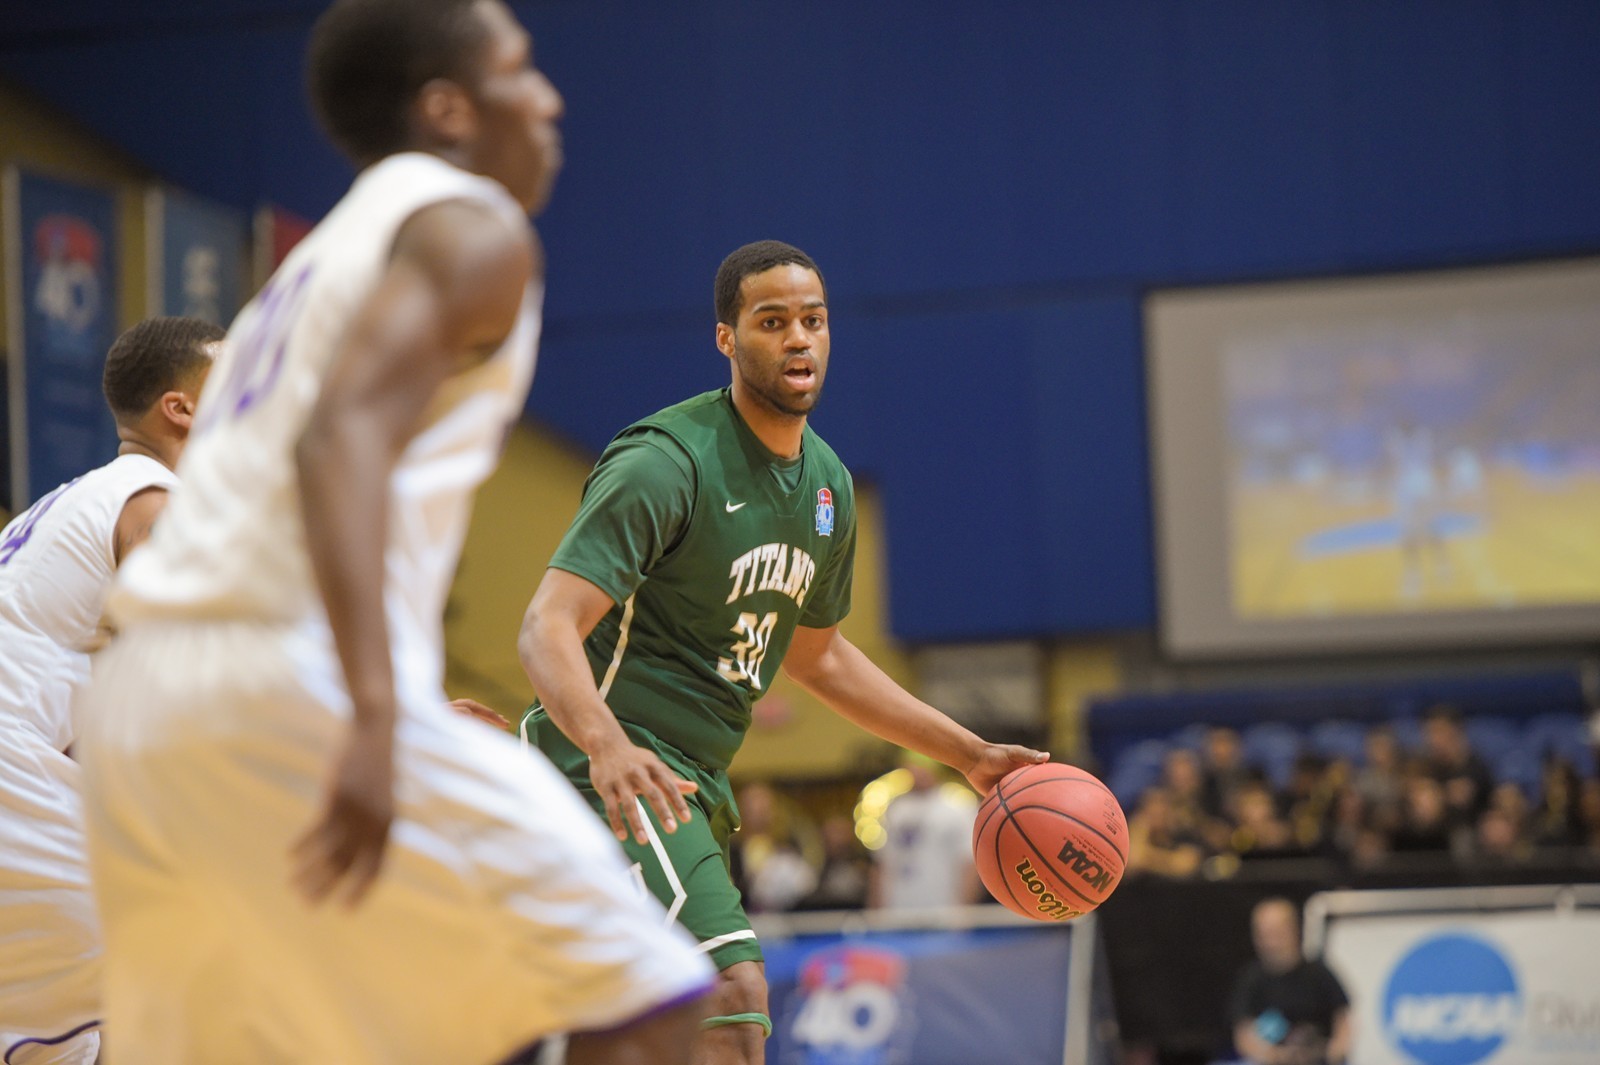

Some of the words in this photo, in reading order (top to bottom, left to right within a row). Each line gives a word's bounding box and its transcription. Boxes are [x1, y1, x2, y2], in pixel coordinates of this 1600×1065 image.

[725, 542, 816, 609] TITANS
[716, 612, 778, 690] 30
[1057, 840, 1115, 893] NCAA
